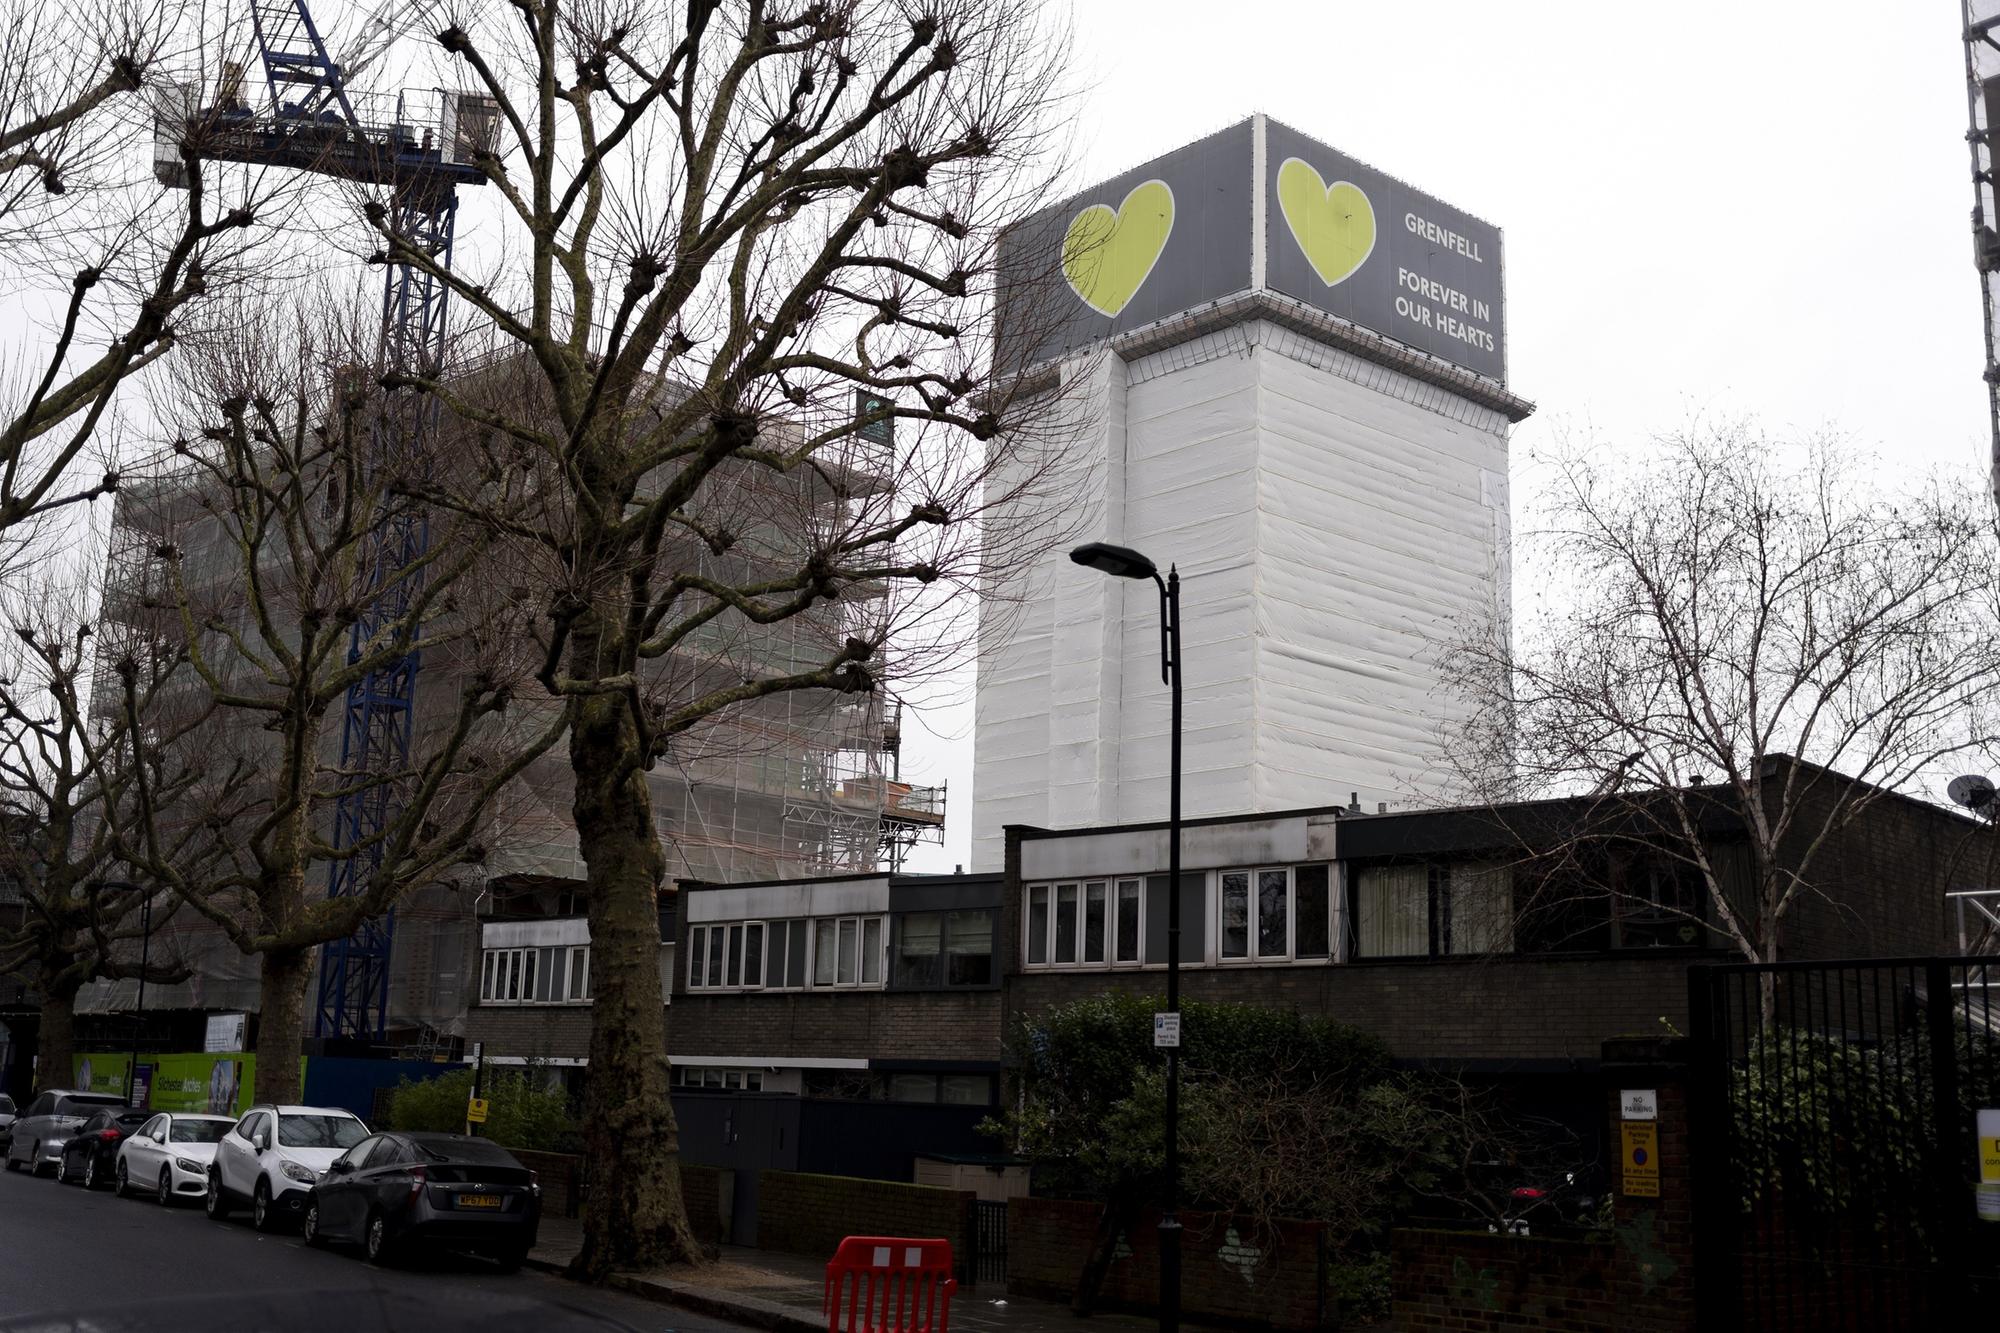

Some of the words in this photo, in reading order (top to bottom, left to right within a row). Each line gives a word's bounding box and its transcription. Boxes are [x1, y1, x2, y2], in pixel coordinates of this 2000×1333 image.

[1405, 212, 1482, 263] GRENFELL
[1398, 267, 1468, 314] FOREVER
[1473, 299, 1490, 322] IN
[1395, 296, 1432, 328] OUR
[1436, 312, 1494, 352] HEARTS
[1624, 1105, 1653, 1113] PARKING
